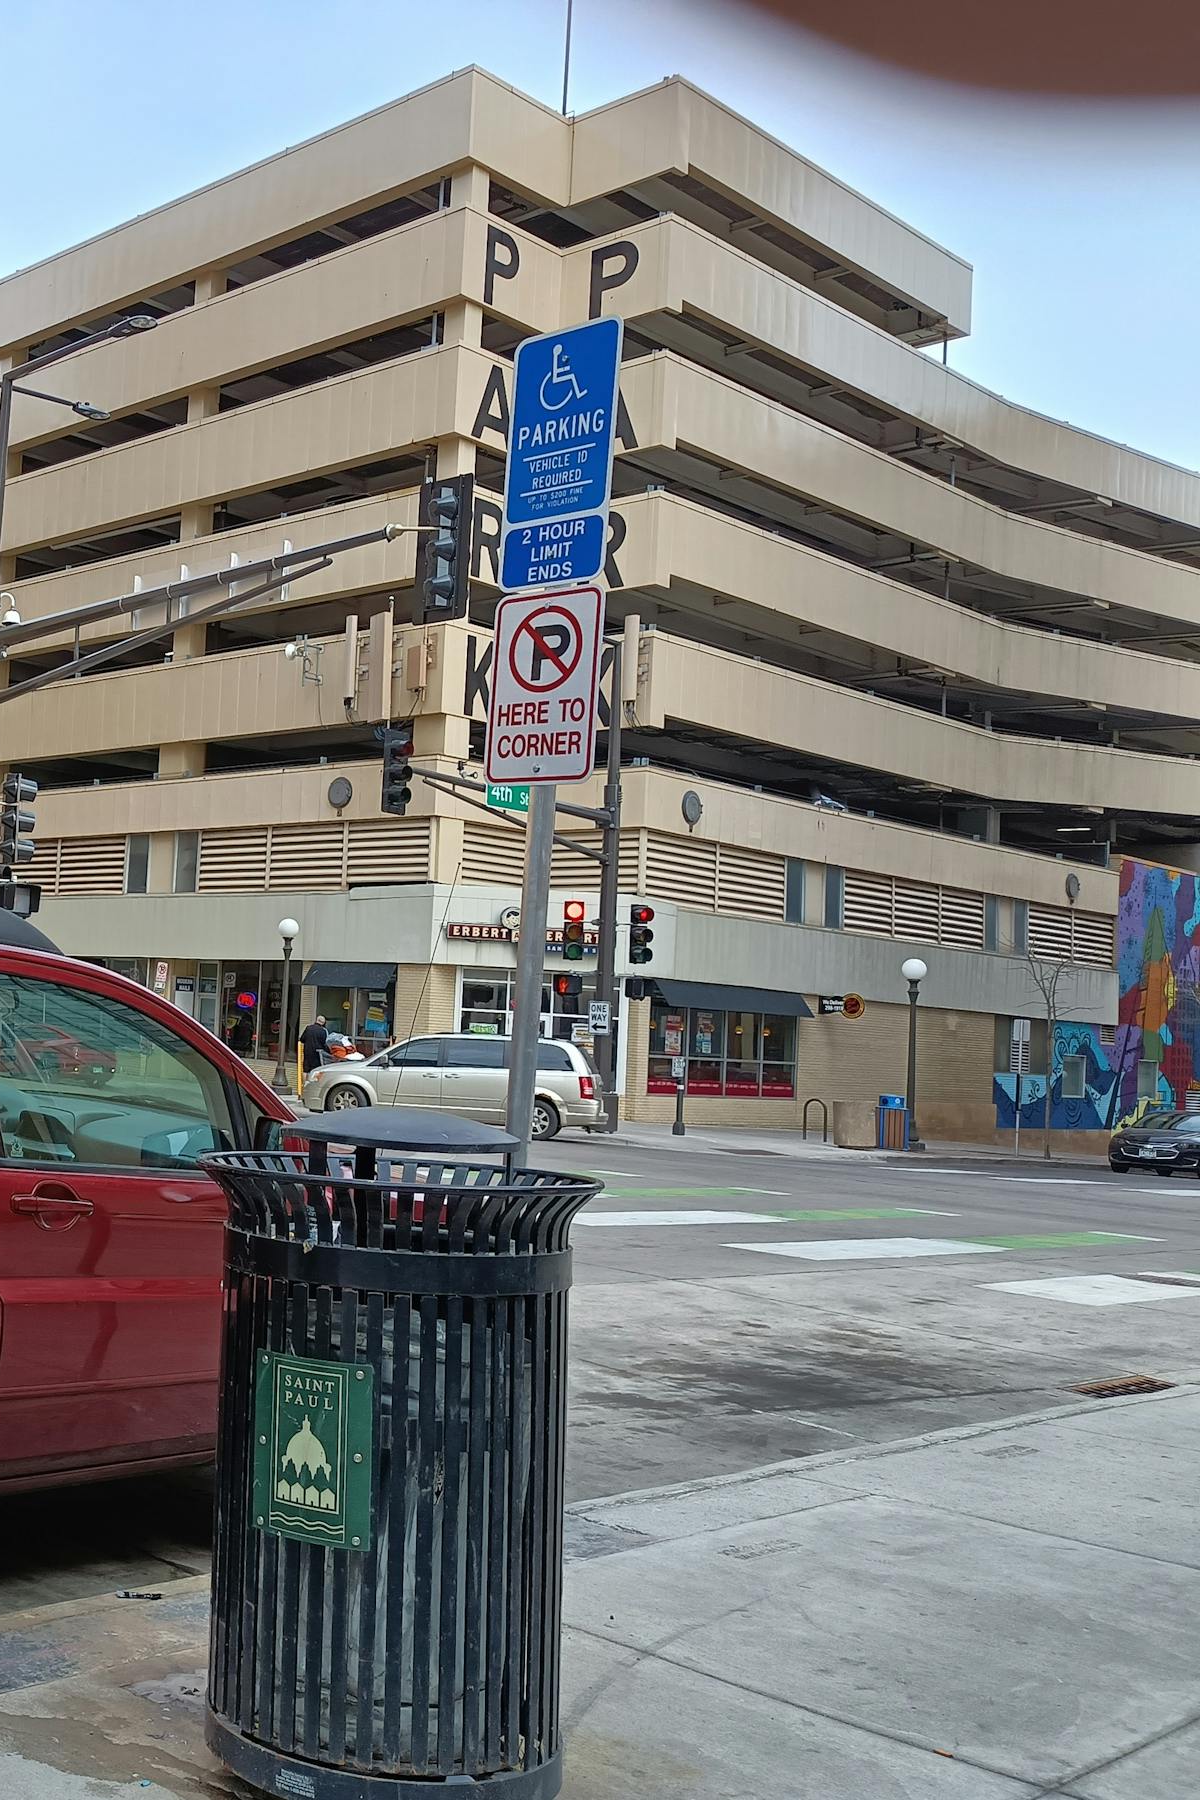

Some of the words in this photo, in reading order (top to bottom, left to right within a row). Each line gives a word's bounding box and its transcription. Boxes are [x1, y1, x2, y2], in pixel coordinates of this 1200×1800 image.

[518, 408, 605, 450] PARKING
[529, 454, 571, 473] VEHICLE
[577, 450, 588, 464] ID
[531, 468, 582, 490] REQUIRED
[527, 496, 536, 504] UP
[540, 494, 548, 502] TO
[550, 490, 567, 500] $200
[531, 503, 544, 511] FOR
[547, 496, 579, 508] VIOLATION
[522, 529, 531, 545] 2
[539, 520, 586, 542] HOUR
[530, 541, 573, 562] LIMIT
[527, 561, 573, 582] ENDS
[497, 700, 550, 727] HERE
[558, 697, 586, 722] TO
[497, 731, 582, 759] CORNER
[491, 786, 512, 803] 4th
[453, 926, 509, 939] ERBERT
[591, 1004, 607, 1013] ONE
[591, 1013, 607, 1022] WAY
[285, 1374, 335, 1394] SAINT
[285, 1391, 334, 1411] PAUL
